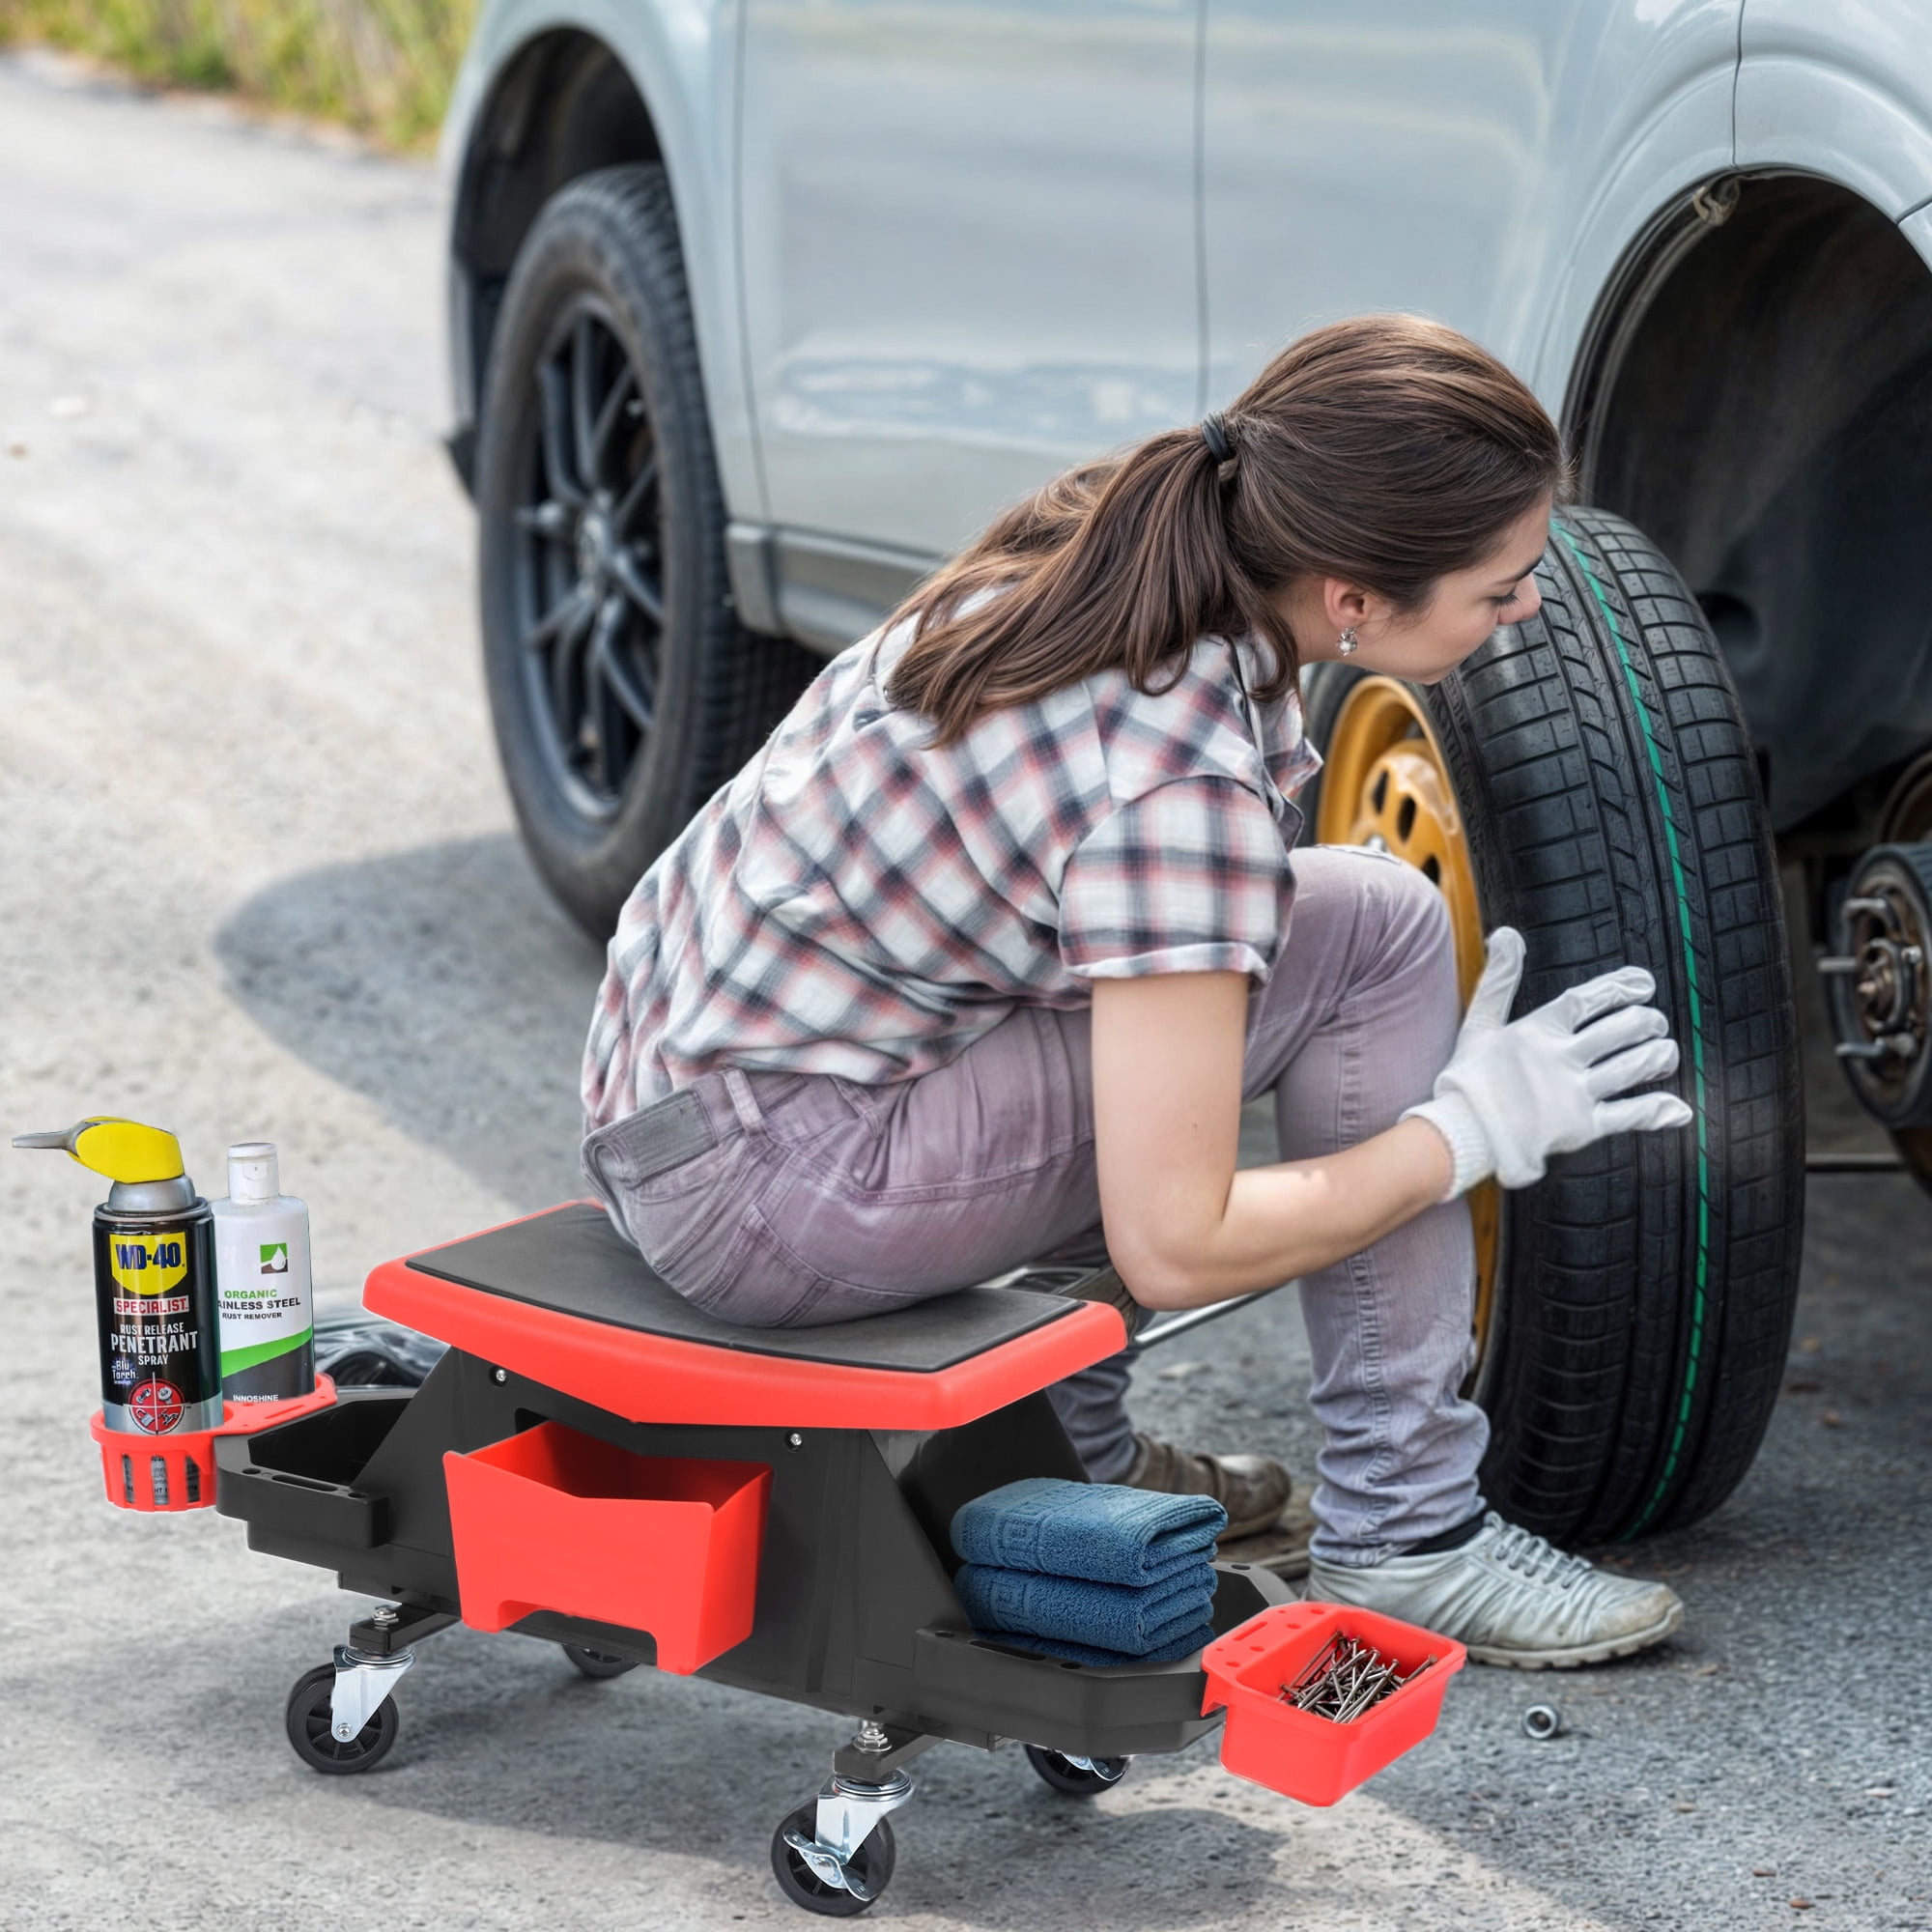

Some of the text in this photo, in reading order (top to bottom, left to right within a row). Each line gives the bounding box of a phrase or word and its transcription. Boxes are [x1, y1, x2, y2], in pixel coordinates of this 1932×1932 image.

[115, 1241, 182, 1270] WD-40
[223, 1289, 277, 1299] ORGANIC
[116, 1297, 187, 1314] SPECIALIST
[217, 1296, 301, 1310] AINLESS STEEL
[120, 1321, 185, 1335] RUST RELEASE
[110, 1331, 198, 1353] PENETRANT
[116, 1359, 129, 1371] Blu
[138, 1354, 169, 1366] SPRAY
[112, 1369, 136, 1379] Torch
